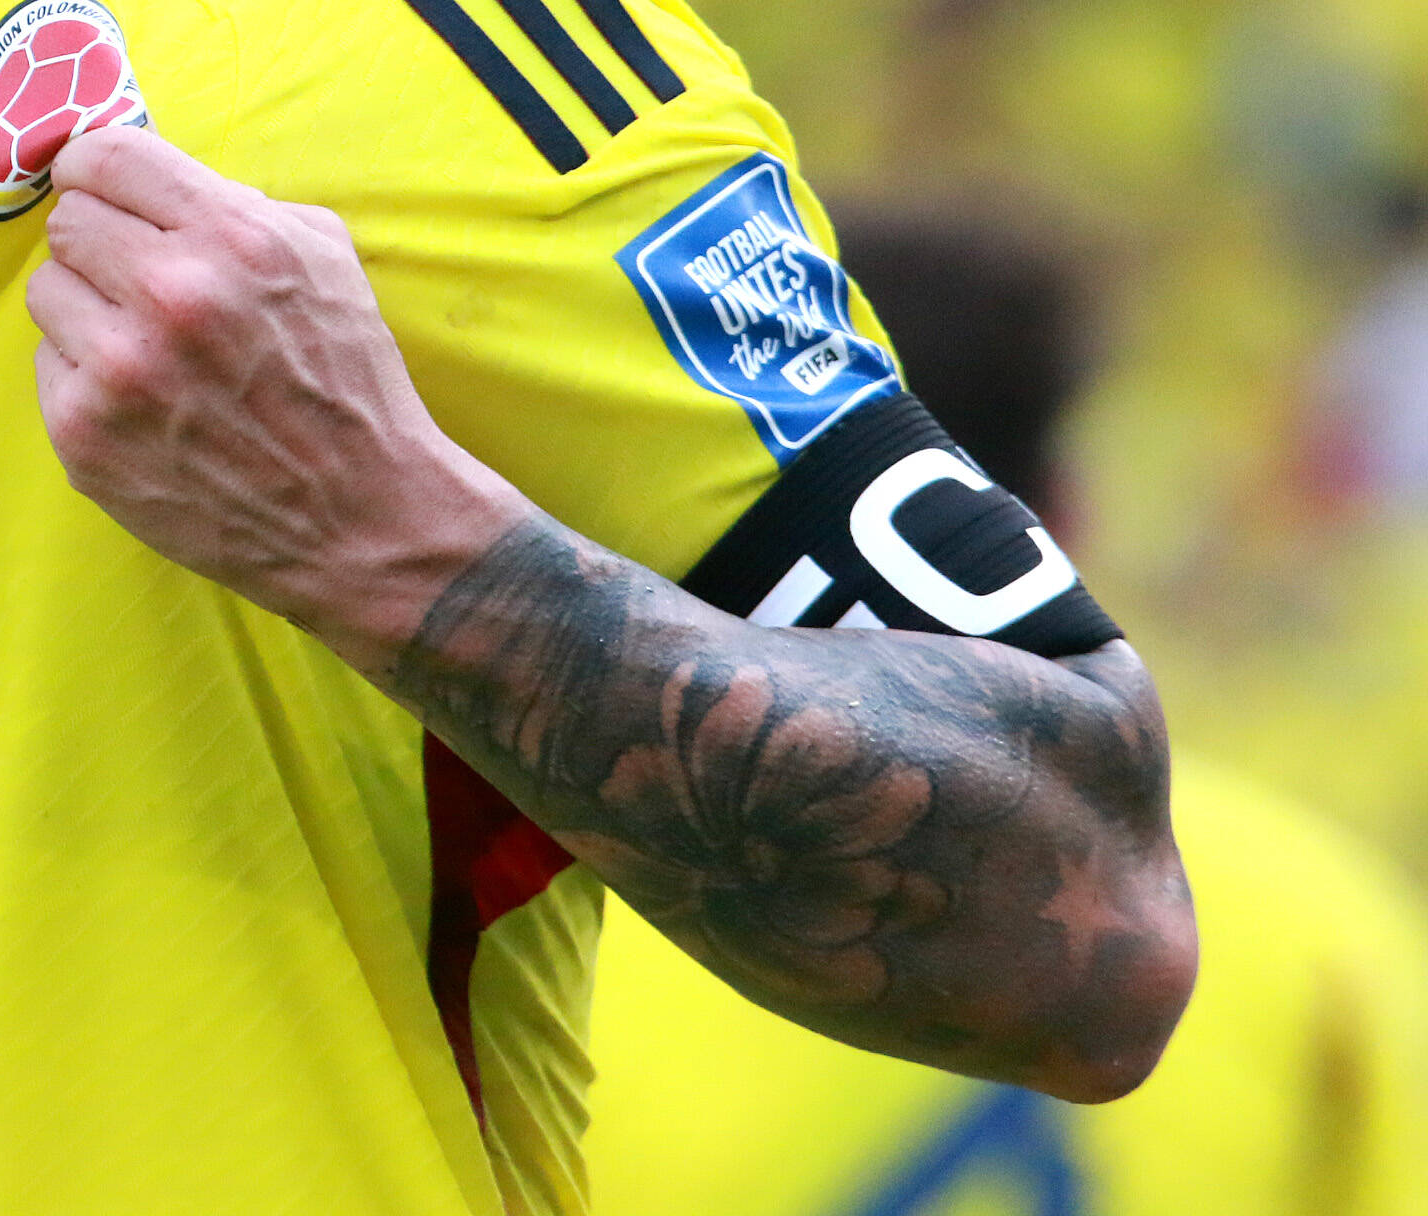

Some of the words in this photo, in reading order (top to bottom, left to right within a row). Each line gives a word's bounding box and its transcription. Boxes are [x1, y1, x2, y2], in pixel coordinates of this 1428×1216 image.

[683, 209, 788, 295] FOOTBALL
[728, 333, 780, 381] the
[796, 346, 840, 385] FIFA
